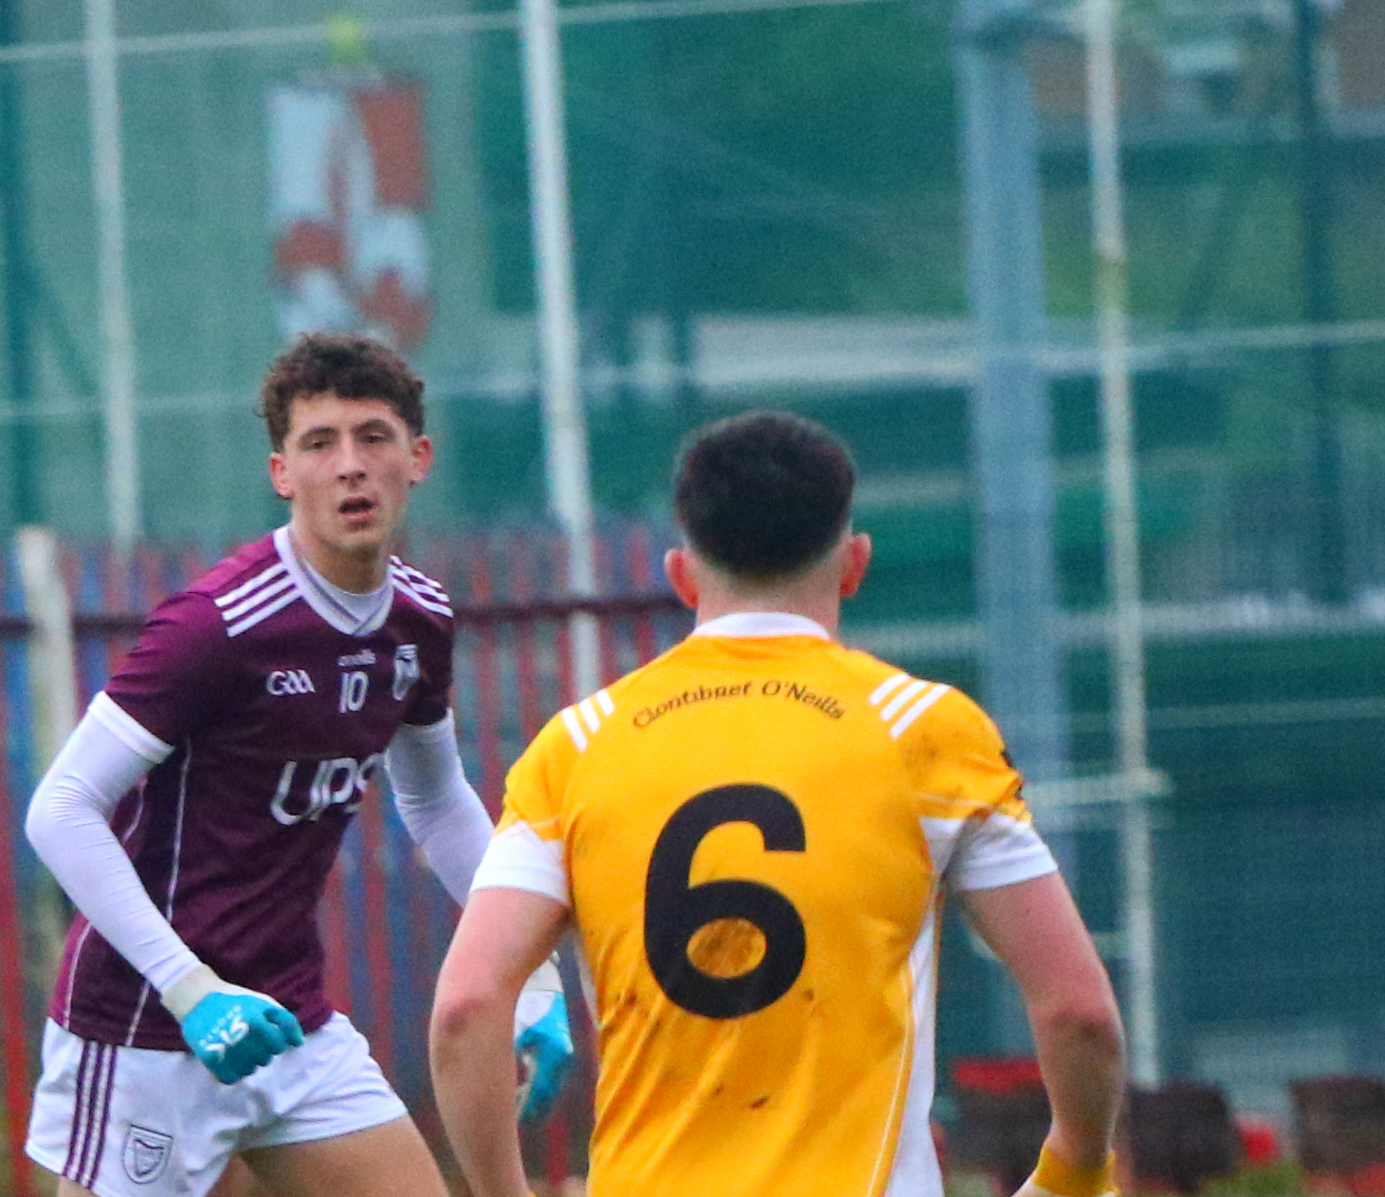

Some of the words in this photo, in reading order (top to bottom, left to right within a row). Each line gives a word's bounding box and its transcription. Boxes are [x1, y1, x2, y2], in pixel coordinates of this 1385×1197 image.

[338, 670, 369, 714] 10
[762, 680, 845, 720] O'Neills
[643, 782, 807, 1020] 6
